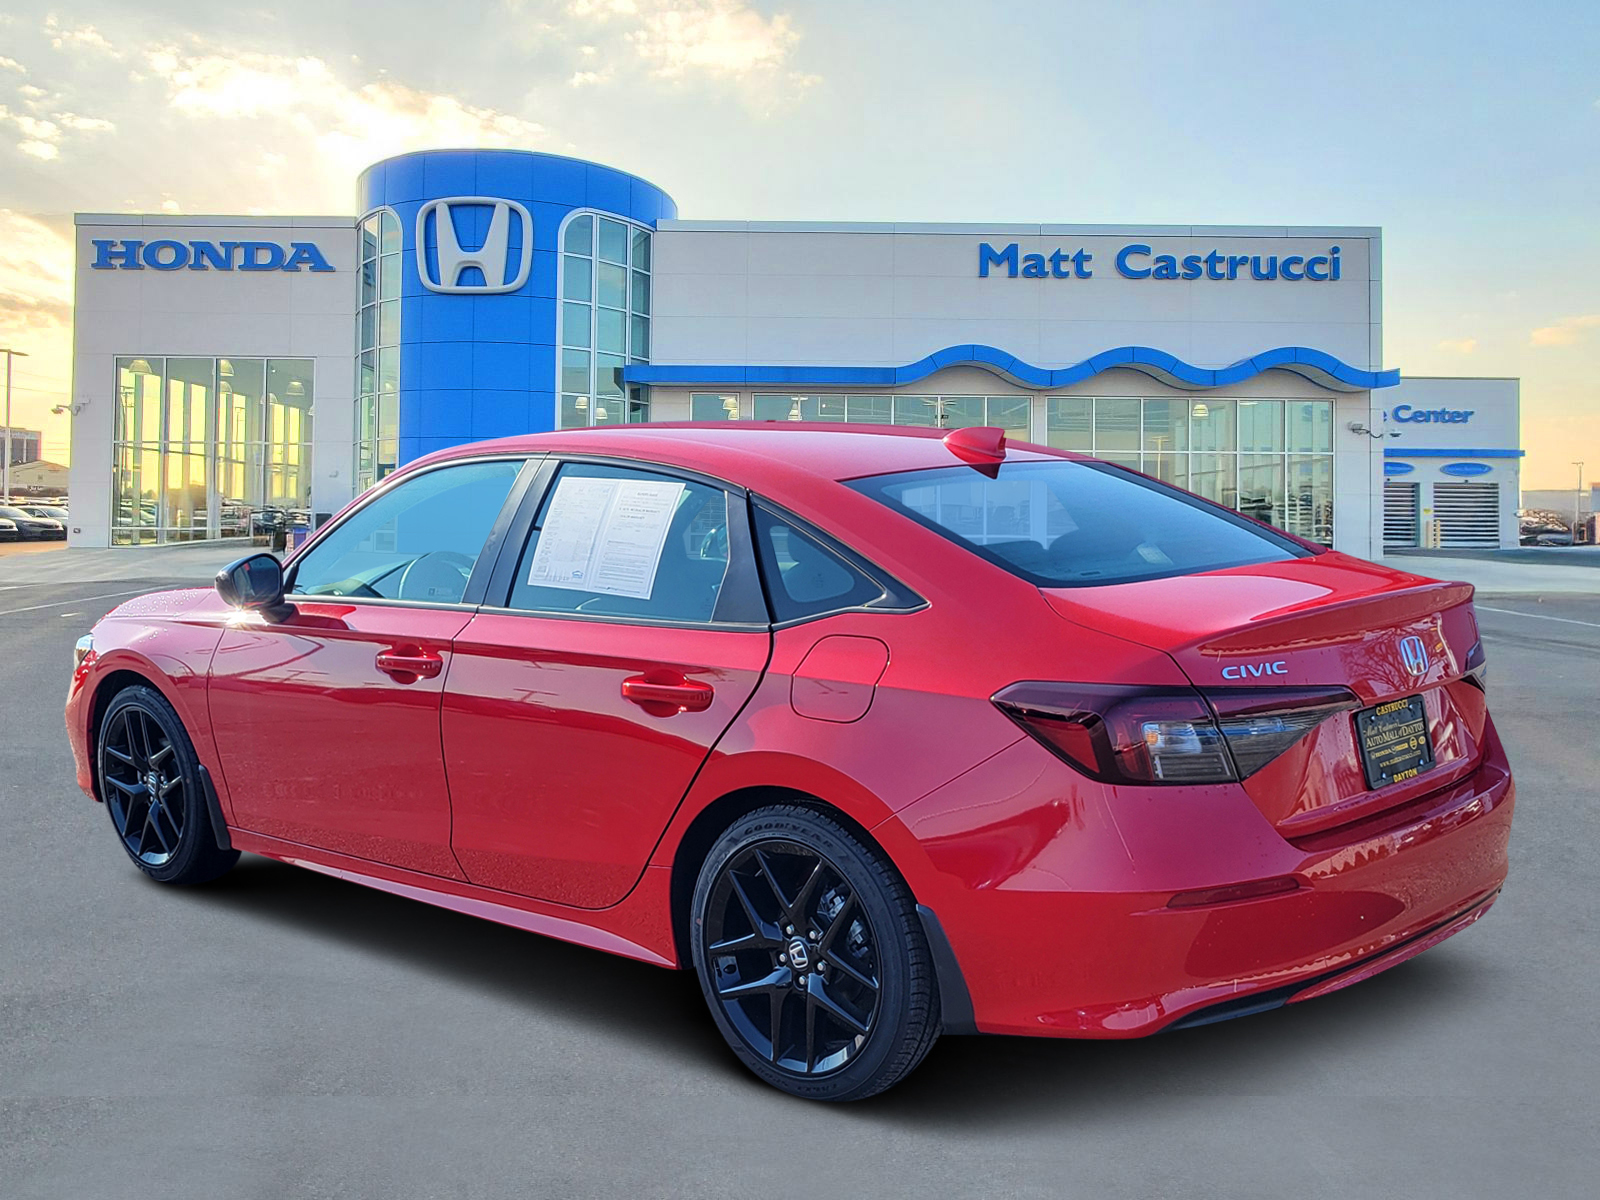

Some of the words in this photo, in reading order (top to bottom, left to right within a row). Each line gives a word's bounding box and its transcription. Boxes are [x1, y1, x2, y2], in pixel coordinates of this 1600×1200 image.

[91, 239, 336, 272] HONDA
[978, 242, 1093, 279] Matt
[1115, 244, 1342, 281] Castrucci
[1392, 404, 1475, 424] Center
[1222, 661, 1288, 680] CIVIC
[1376, 699, 1408, 715] CASTRUCCI
[1393, 767, 1418, 783] DAYTON
[744, 822, 834, 848] GOODYEAR
